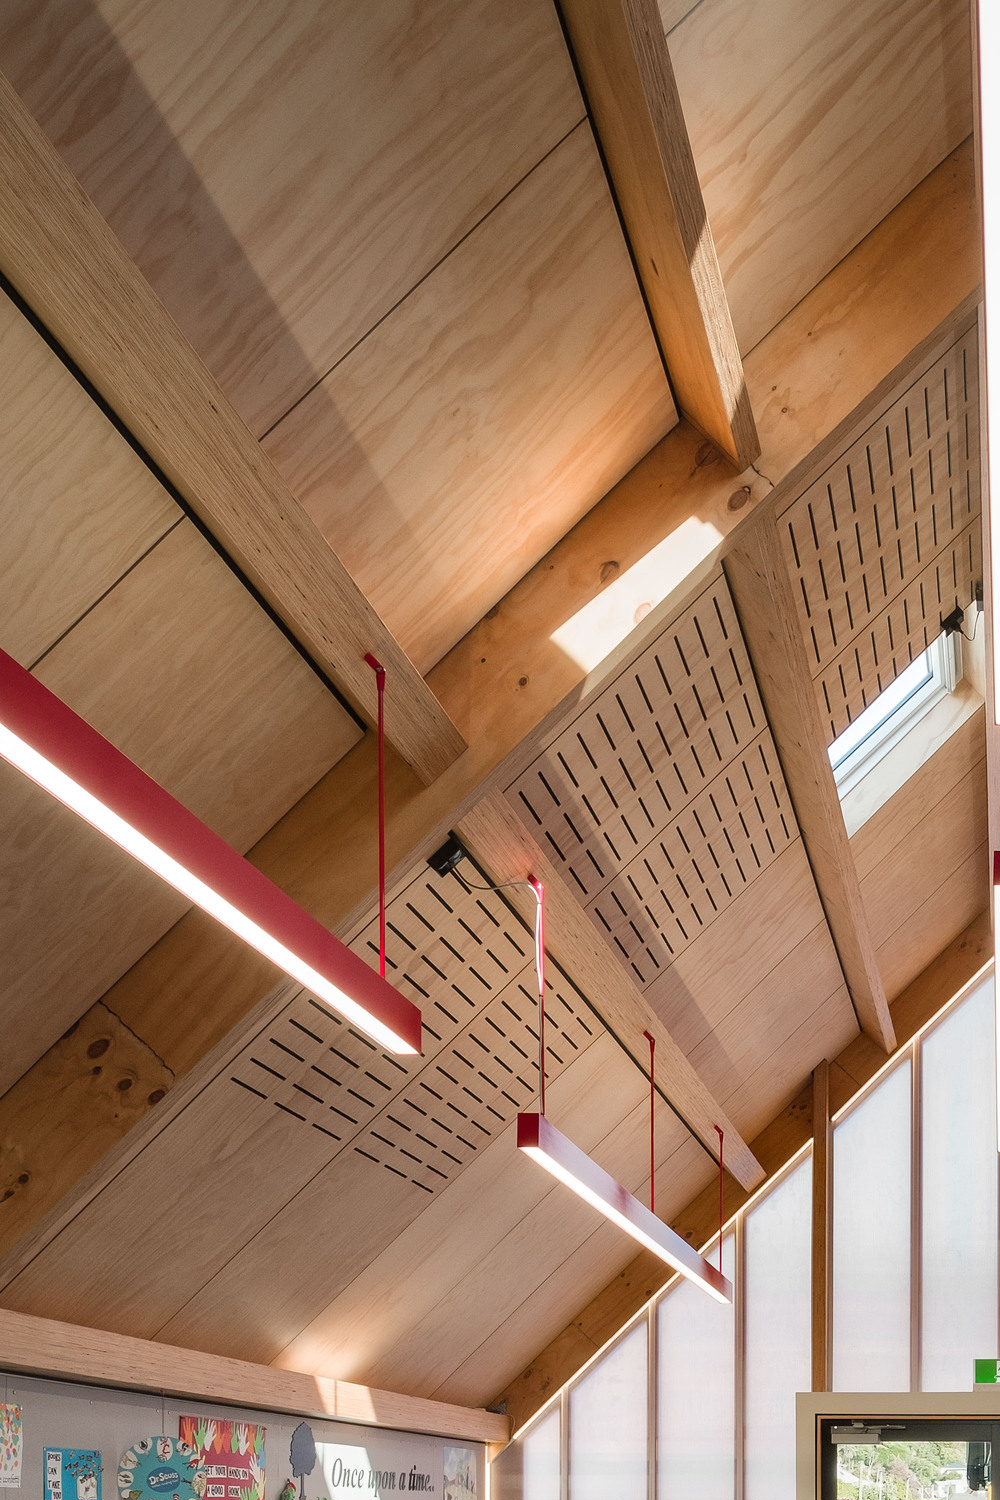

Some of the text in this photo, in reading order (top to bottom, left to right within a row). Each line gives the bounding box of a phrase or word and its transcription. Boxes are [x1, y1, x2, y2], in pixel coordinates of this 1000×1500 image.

[47, 1452, 61, 1461] BOOKS
[48, 1466, 58, 1475] CAN
[159, 1472, 179, 1482] Seuss
[331, 1457, 364, 1488] Once
[368, 1467, 396, 1497] upon
[399, 1472, 406, 1491] a
[48, 1480, 61, 1489] TAKE
[53, 1491, 62, 1500] YOU
